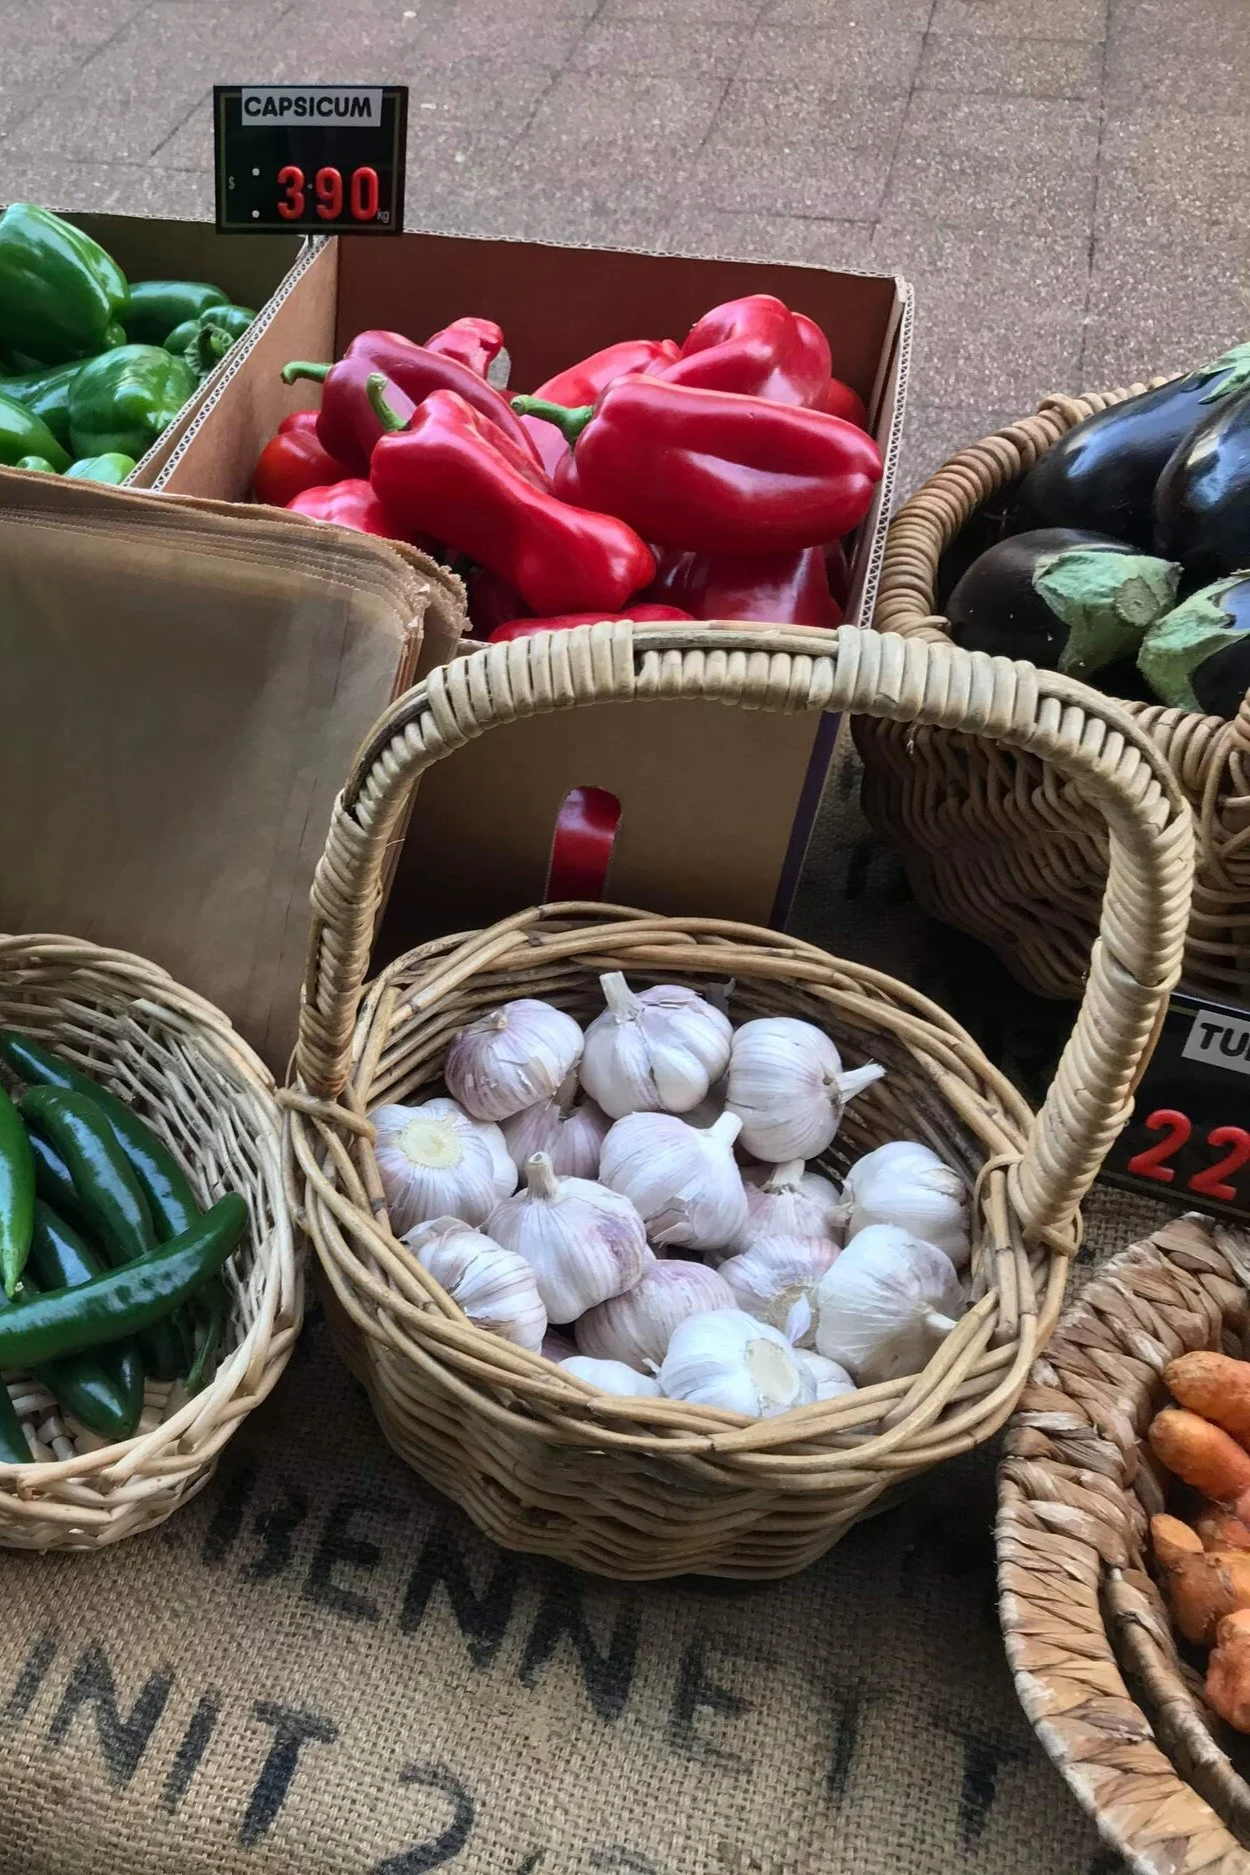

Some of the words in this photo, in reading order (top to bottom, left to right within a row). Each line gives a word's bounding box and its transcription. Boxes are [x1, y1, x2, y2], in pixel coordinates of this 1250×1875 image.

[243, 96, 372, 118] CAPSICUM
[227, 175, 236, 190] $
[376, 209, 391, 223] kg
[1200, 1021, 1250, 1062] TU
